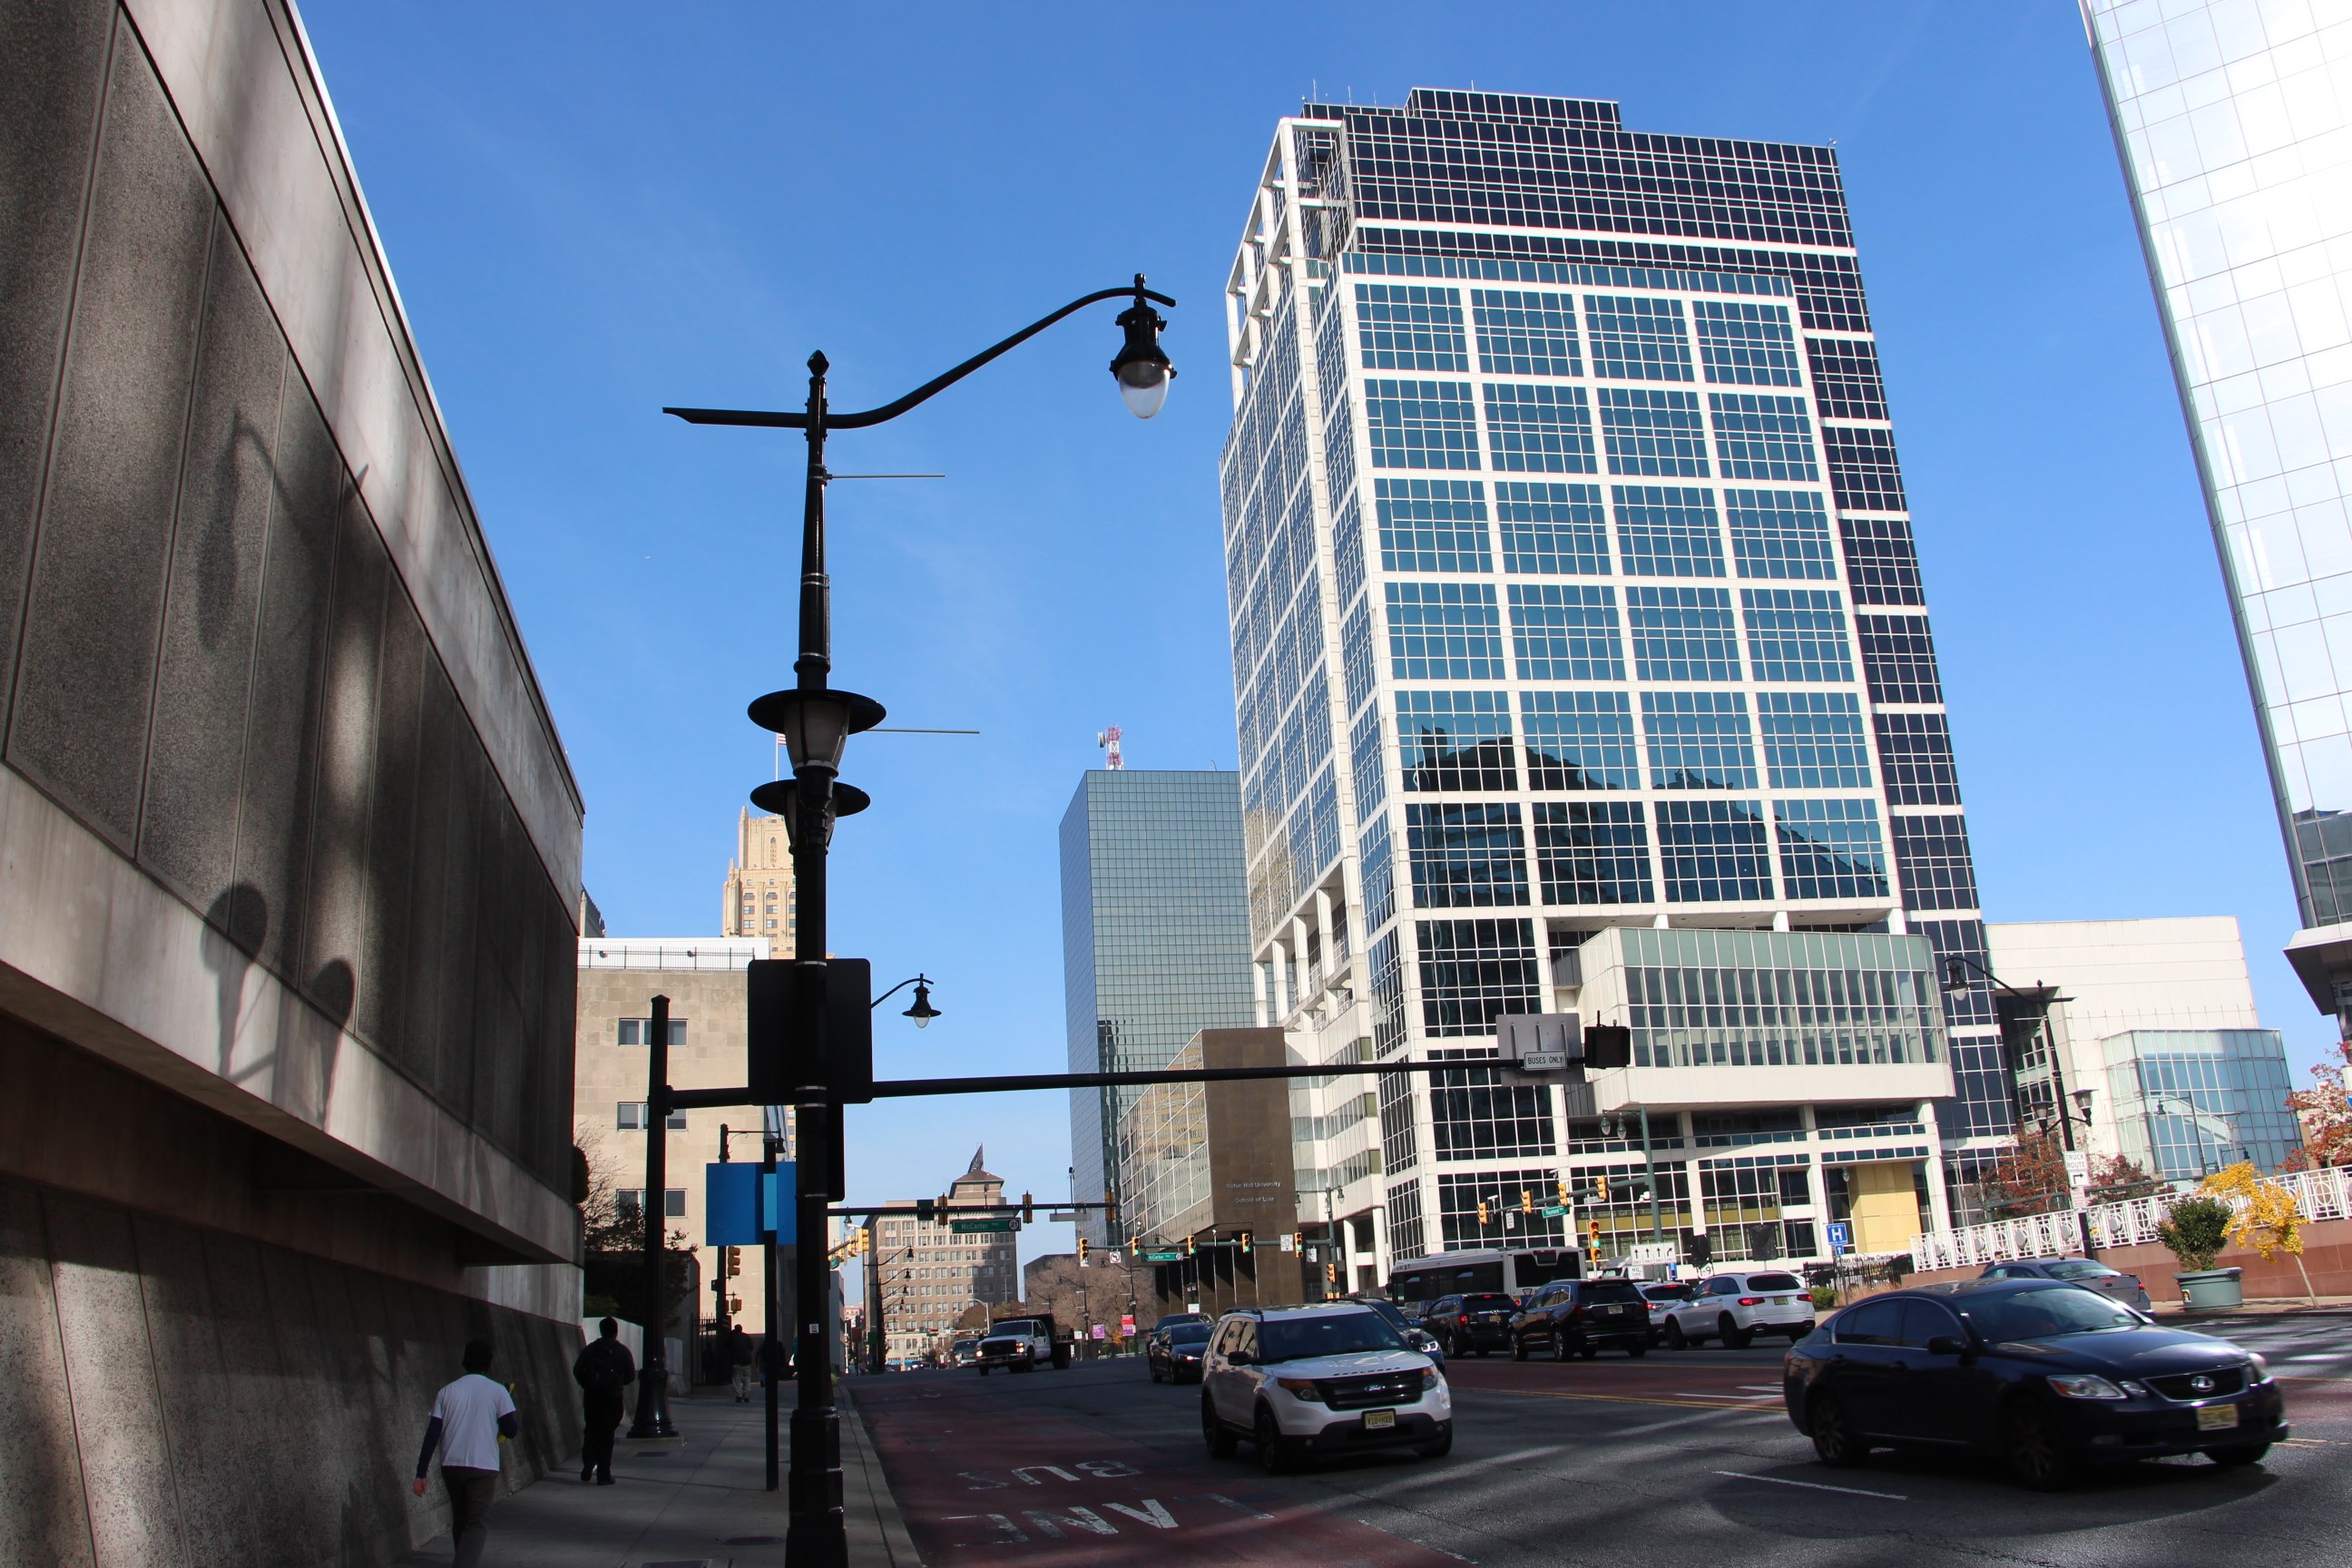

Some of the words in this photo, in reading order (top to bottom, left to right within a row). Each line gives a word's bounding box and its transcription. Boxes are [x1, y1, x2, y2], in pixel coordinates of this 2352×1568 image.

[1527, 1056, 1546, 1064] BUSES
[1548, 1055, 1563, 1063] ONLY
[2065, 1152, 2085, 1161] TRUCK
[1831, 1228, 1842, 1241] H
[1333, 1367, 1401, 1377] EXPLORER
